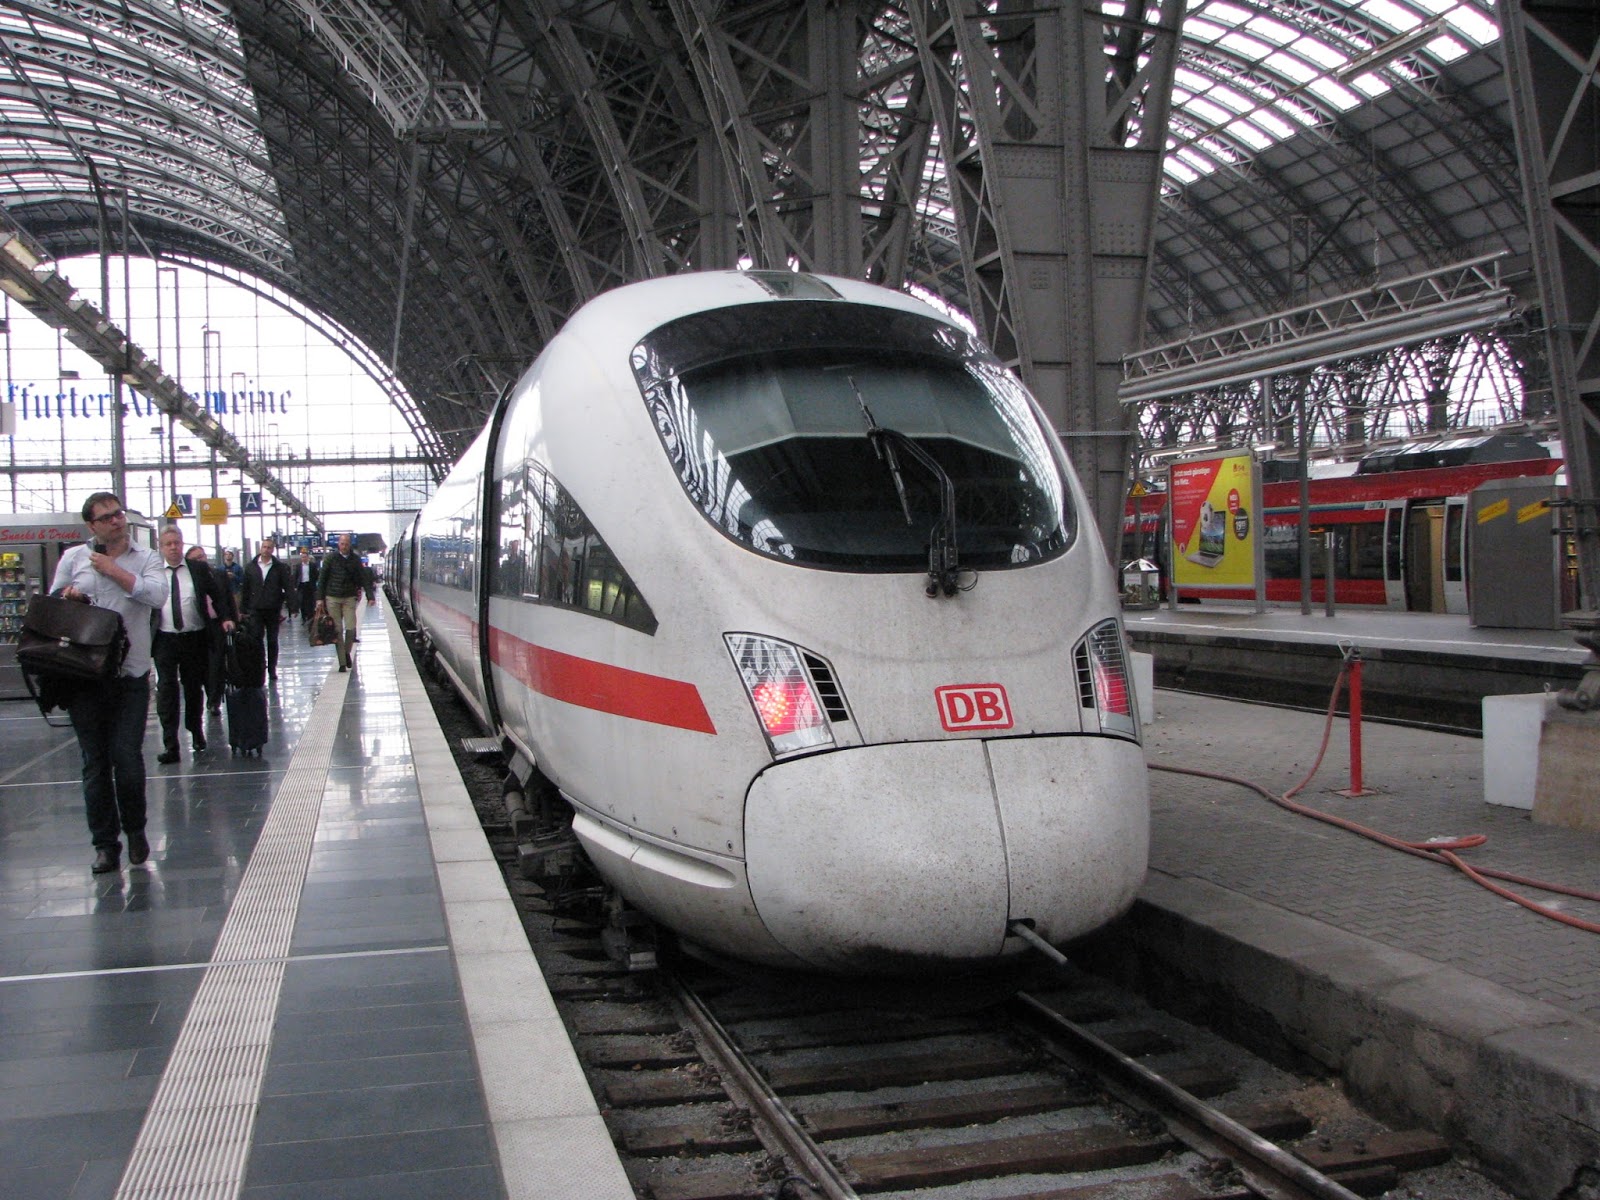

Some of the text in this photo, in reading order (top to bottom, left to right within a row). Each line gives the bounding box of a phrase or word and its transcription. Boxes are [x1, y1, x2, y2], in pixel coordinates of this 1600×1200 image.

[176, 495, 187, 510] A
[245, 493, 258, 508] A
[1, 527, 82, 541] Snacks & Drinks
[945, 690, 1003, 723] DB
